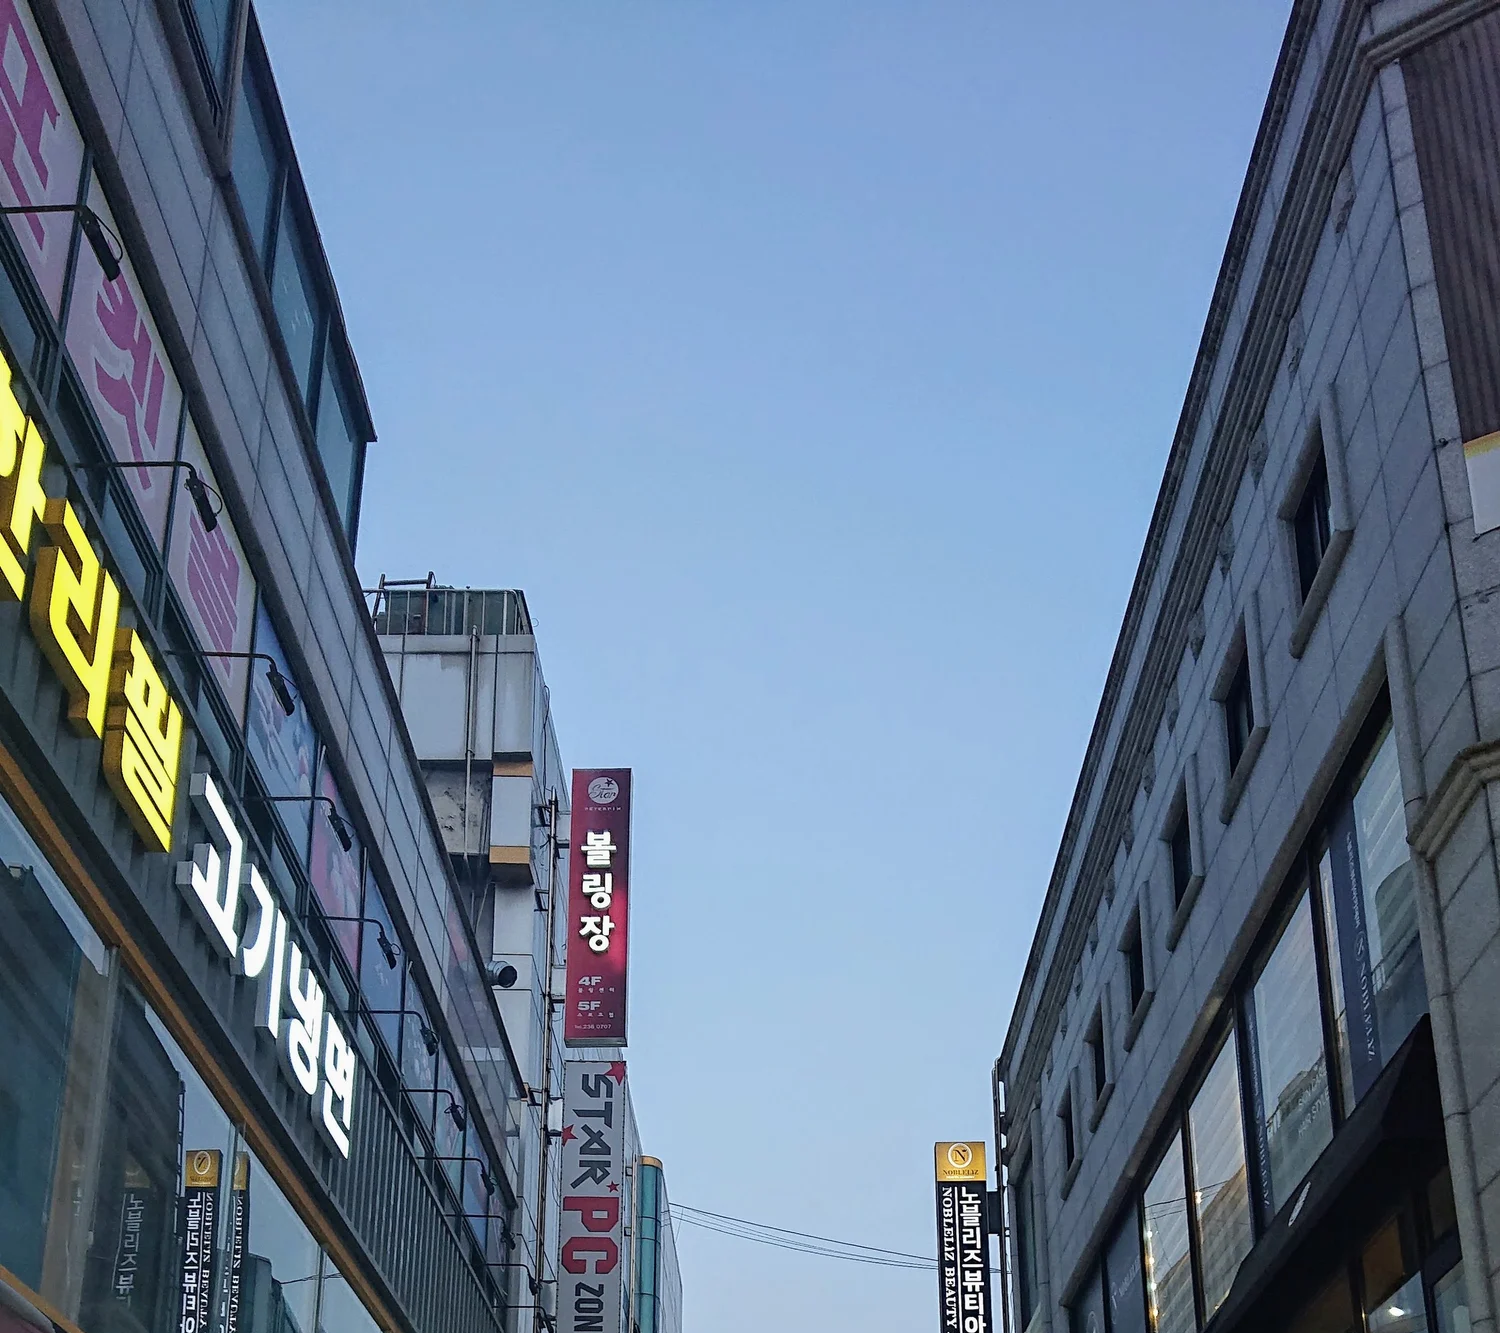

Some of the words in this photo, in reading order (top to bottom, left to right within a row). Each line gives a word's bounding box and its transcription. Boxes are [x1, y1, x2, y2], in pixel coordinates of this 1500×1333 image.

[580, 831, 617, 952] 볼링장
[191, 772, 357, 1160] 고기냉면
[578, 976, 602, 986] 4F
[577, 1001, 601, 1011] 5F
[570, 1074, 613, 1189] STAR
[561, 1196, 619, 1274] PC
[944, 1267, 958, 1328] BEAUTY
